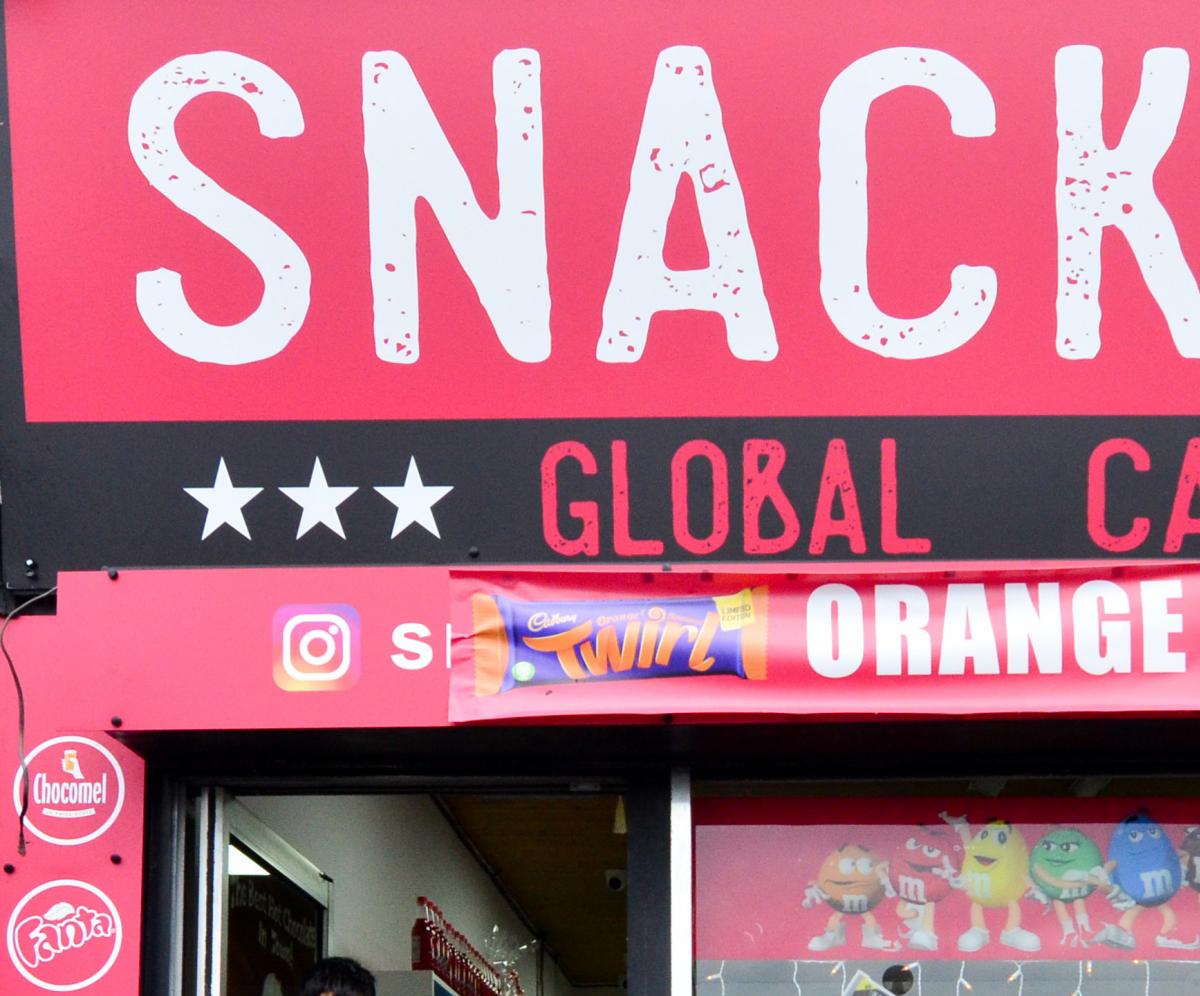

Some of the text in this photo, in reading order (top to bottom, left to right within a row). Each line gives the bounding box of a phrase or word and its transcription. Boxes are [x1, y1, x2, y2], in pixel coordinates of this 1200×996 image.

[540, 437, 932, 557] GLOBAL
[390, 623, 452, 671] S
[522, 607, 720, 679] Twirl
[527, 611, 578, 632] Cadbury
[805, 579, 1188, 678] ORANGE
[33, 772, 107, 805] Chocomel
[1140, 868, 1175, 899] m
[15, 905, 114, 969] Fanta
